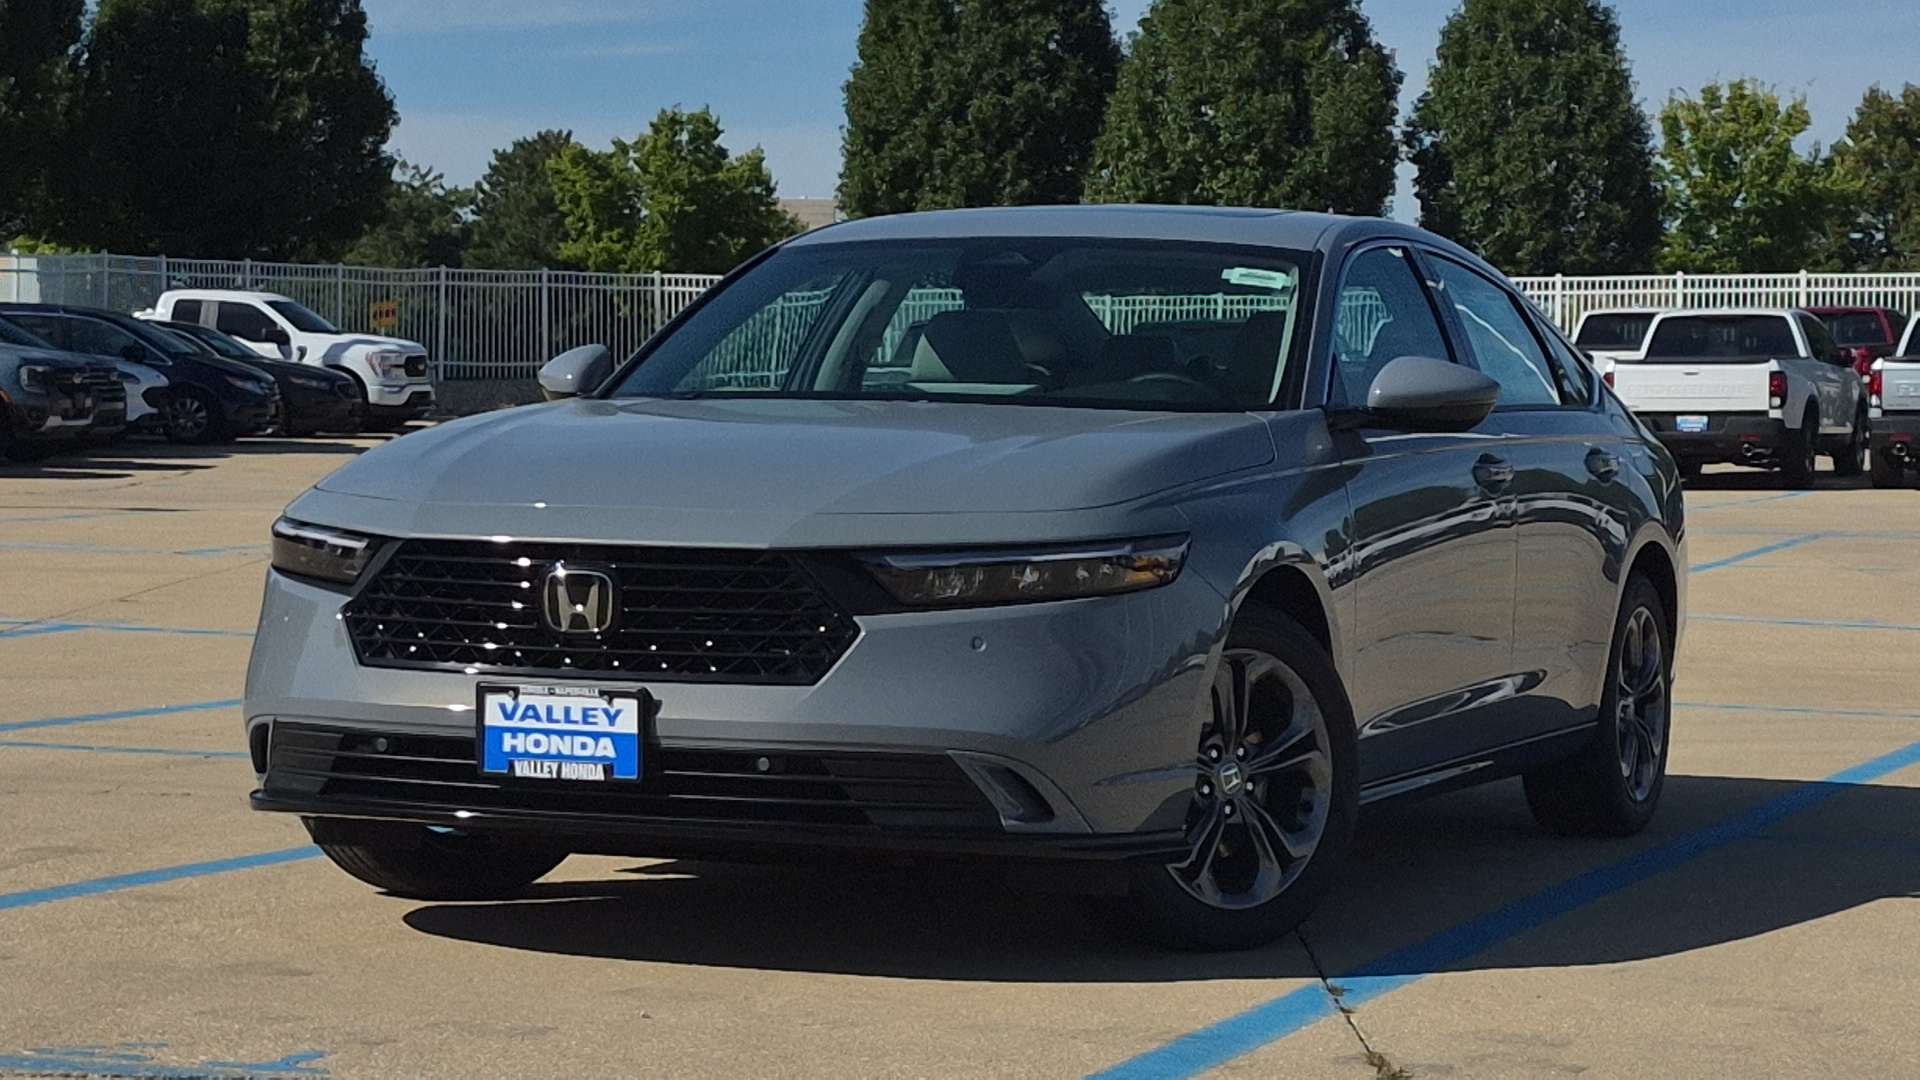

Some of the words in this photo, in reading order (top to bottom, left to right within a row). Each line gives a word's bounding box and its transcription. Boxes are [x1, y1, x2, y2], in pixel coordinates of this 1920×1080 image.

[498, 702, 623, 727] VALLEY
[502, 732, 617, 758] HONDA
[514, 760, 559, 779] VALLEY
[560, 761, 605, 781] HONDA
